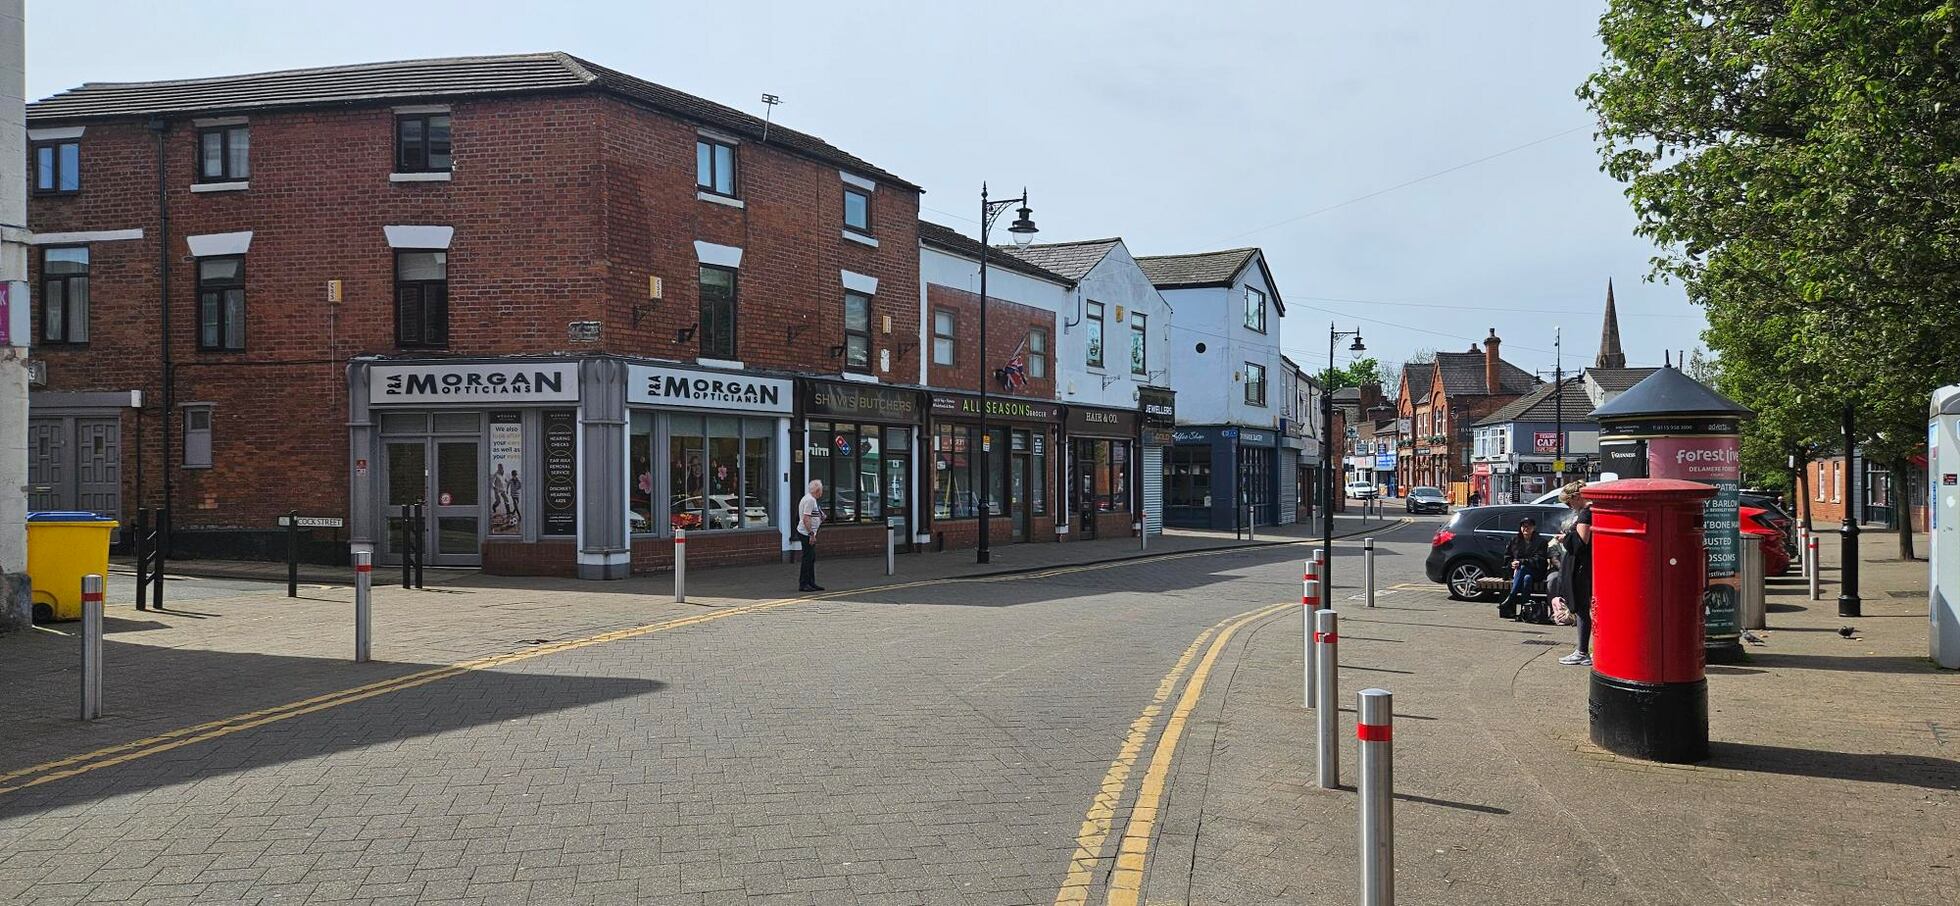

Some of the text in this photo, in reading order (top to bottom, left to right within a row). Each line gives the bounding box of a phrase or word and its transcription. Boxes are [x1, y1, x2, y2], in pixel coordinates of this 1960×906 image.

[386, 374, 402, 395] P&A
[405, 371, 561, 395] MORGAN
[441, 385, 531, 395] OPTICIANS
[648, 375, 661, 396] P&A
[664, 376, 778, 405] MORGAN
[693, 391, 759, 404] OPTICIANS
[859, 397, 911, 412] BUTCHERS
[963, 399, 981, 413] ALL
[985, 401, 1030, 416] SEASONS
[1145, 404, 1172, 415] JEWELLERS
[1085, 412, 1102, 422] HAIR
[1675, 449, 1724, 464] forest
[316, 519, 342, 527] STREET
